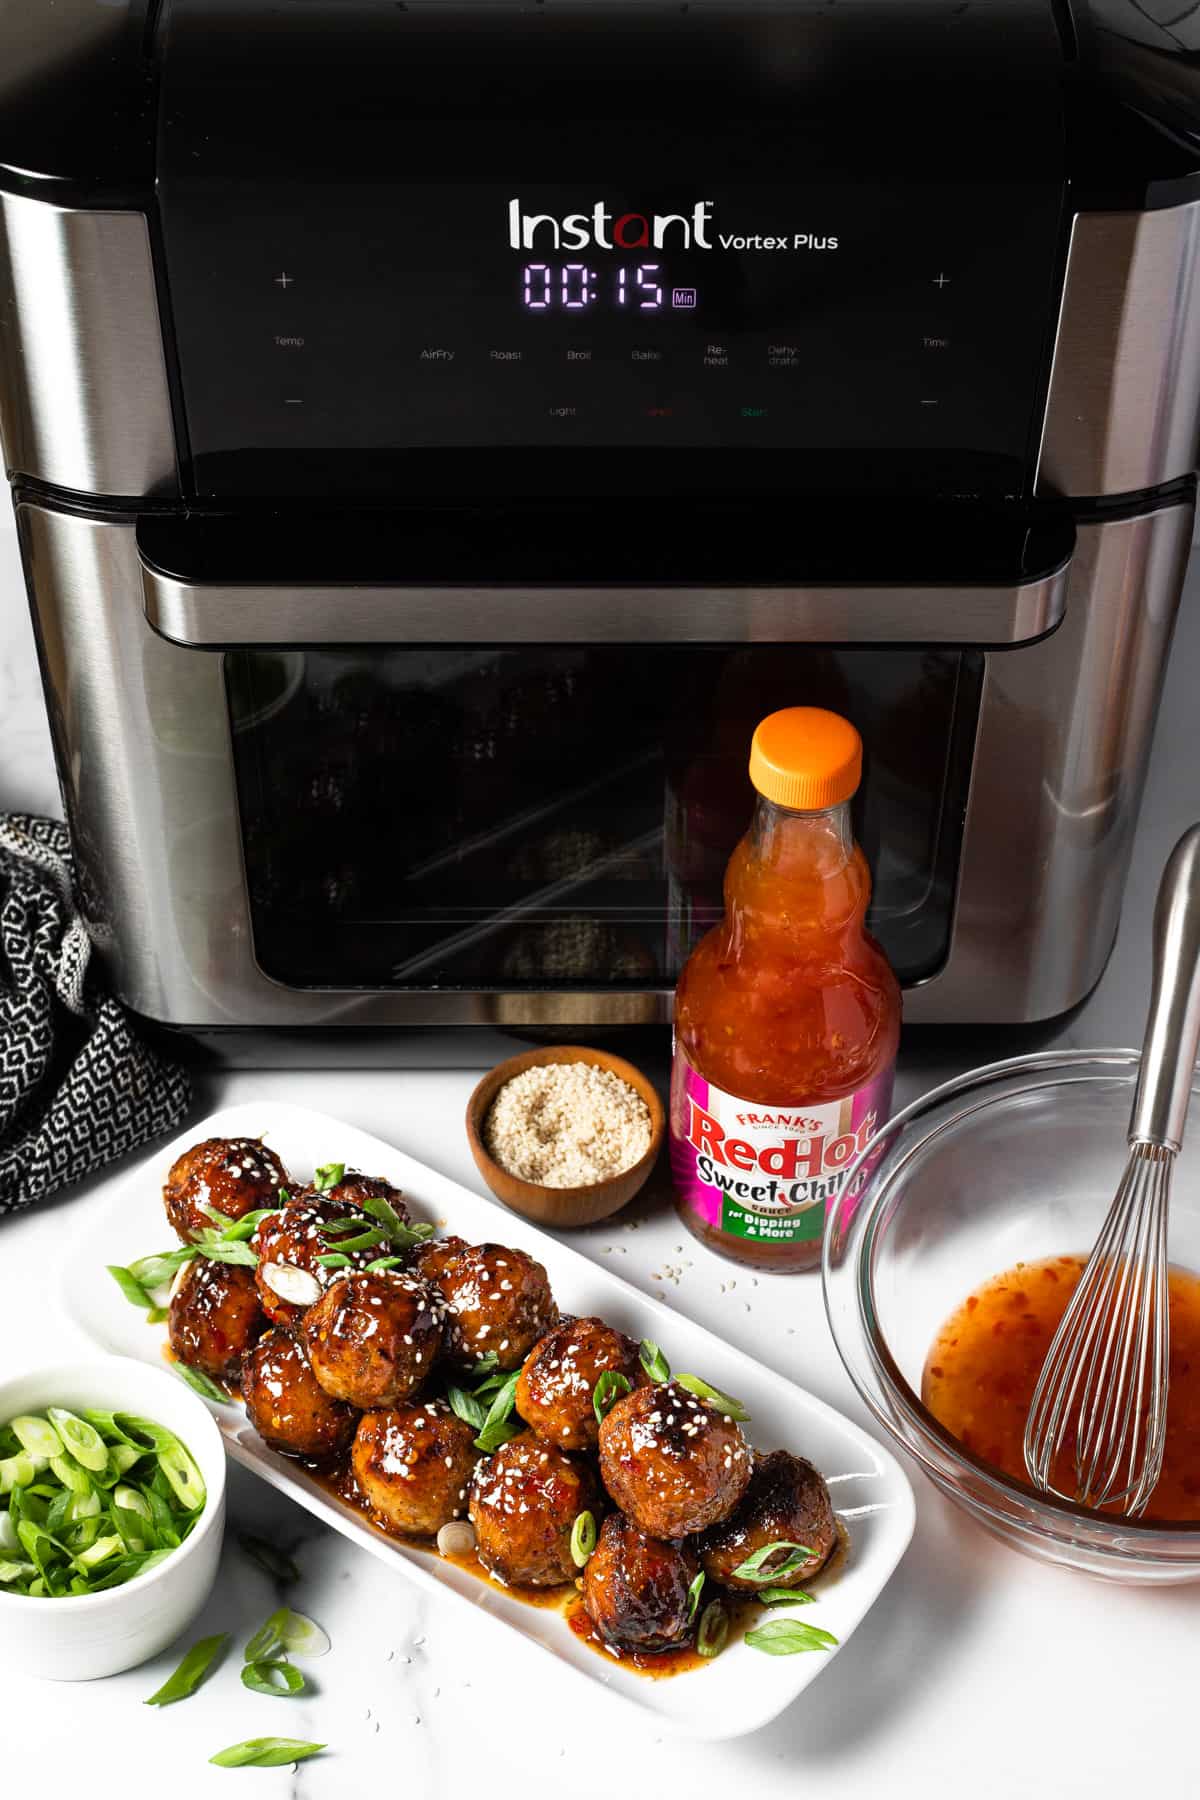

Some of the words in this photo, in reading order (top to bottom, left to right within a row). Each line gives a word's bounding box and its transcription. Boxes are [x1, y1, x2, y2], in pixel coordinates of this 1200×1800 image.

[508, 198, 713, 250] Instant
[718, 234, 788, 250] Vortex
[793, 233, 840, 250] Plus
[524, 264, 663, 308] 00:15
[675, 291, 694, 305] Min
[274, 336, 304, 348] Temp
[420, 350, 455, 361] AirFry
[735, 1113, 824, 1131] FRANK'S
[690, 1100, 876, 1179] RedHot
[698, 1156, 779, 1203] Sweet
[744, 1213, 801, 1228] Dipping
[745, 1226, 757, 1235] &
[759, 1226, 794, 1238] More
